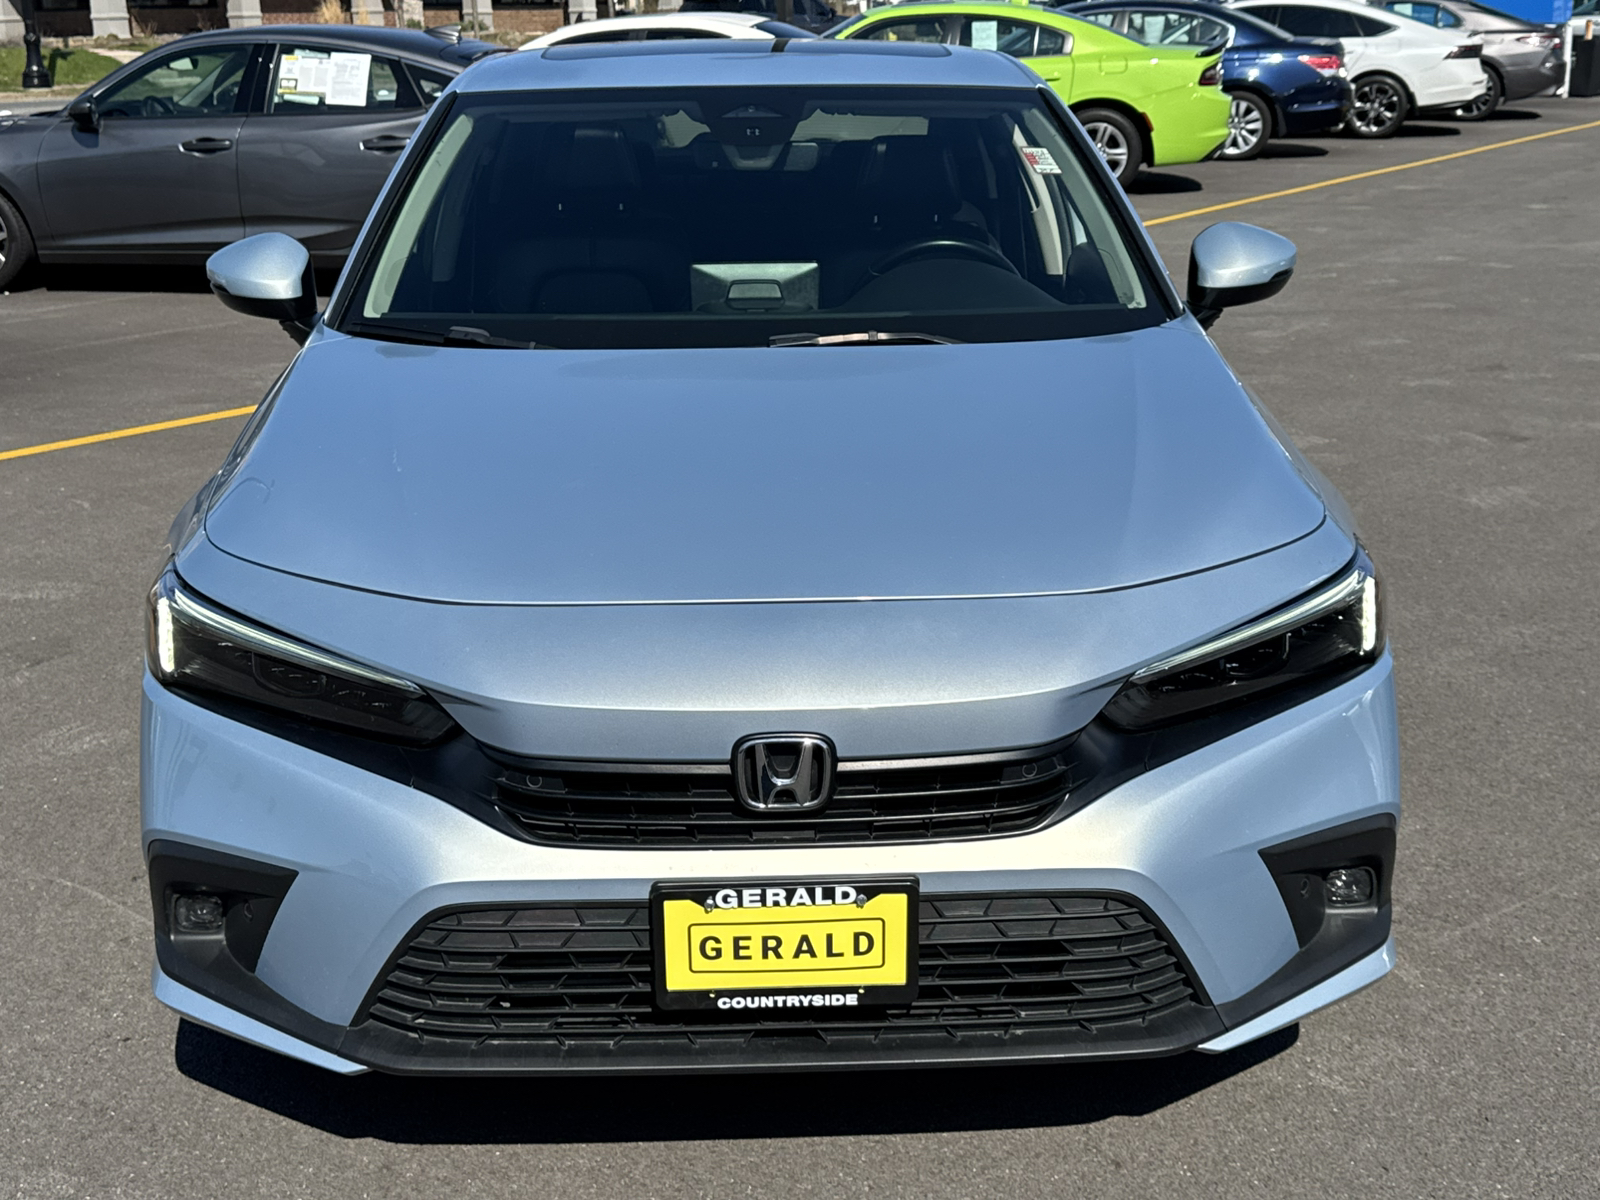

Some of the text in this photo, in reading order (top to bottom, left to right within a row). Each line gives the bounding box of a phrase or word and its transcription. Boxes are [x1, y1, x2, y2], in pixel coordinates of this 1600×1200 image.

[715, 886, 857, 909] GERALD
[699, 931, 875, 960] GERALD
[717, 993, 858, 1009] COUNTRYSIDE
